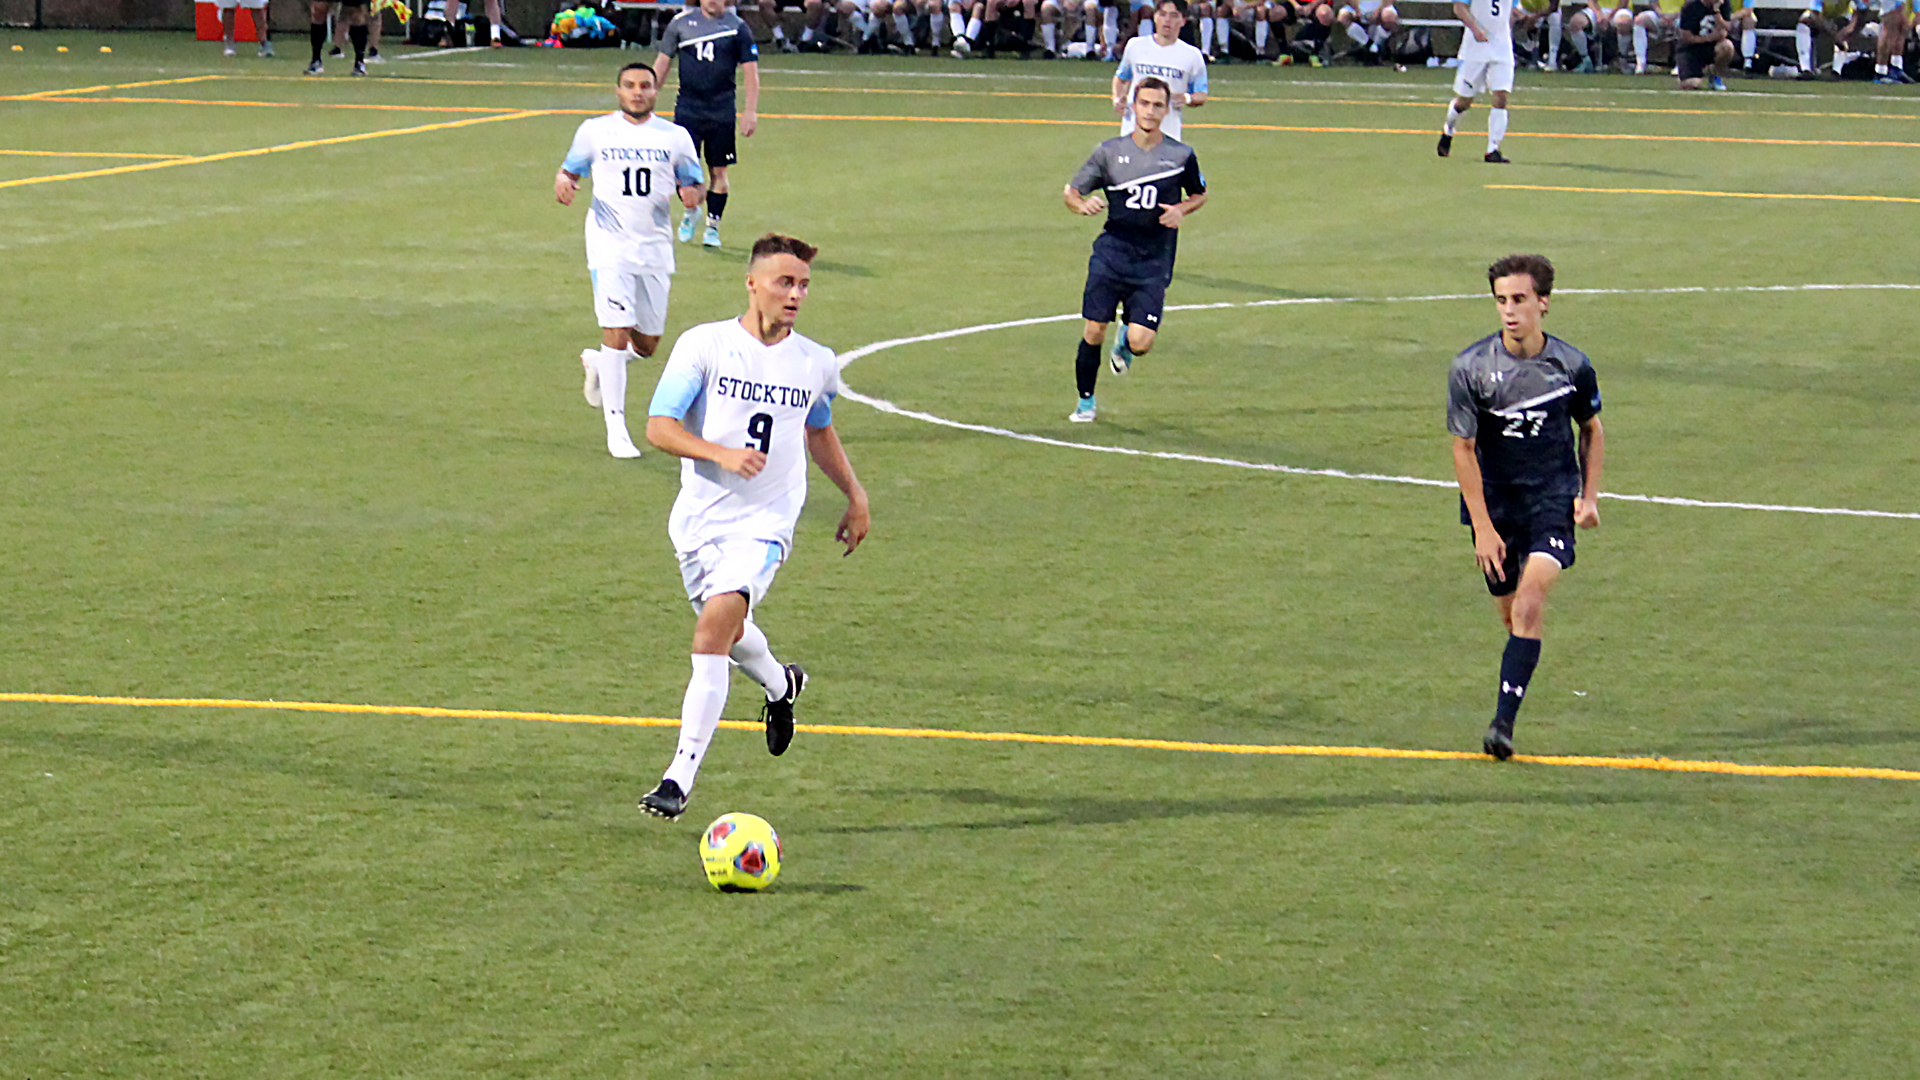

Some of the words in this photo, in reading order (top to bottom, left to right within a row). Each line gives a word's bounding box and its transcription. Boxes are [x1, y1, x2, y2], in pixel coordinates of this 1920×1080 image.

[1491, 0, 1500, 16] 5
[695, 41, 715, 62] 14
[1135, 63, 1184, 79] STOCKTON
[601, 148, 671, 161] STOCKTON
[622, 167, 651, 196] 10
[1125, 185, 1158, 209] 20
[717, 376, 812, 409] STOCKTON
[745, 412, 774, 455] 9
[1502, 410, 1548, 439] 27
